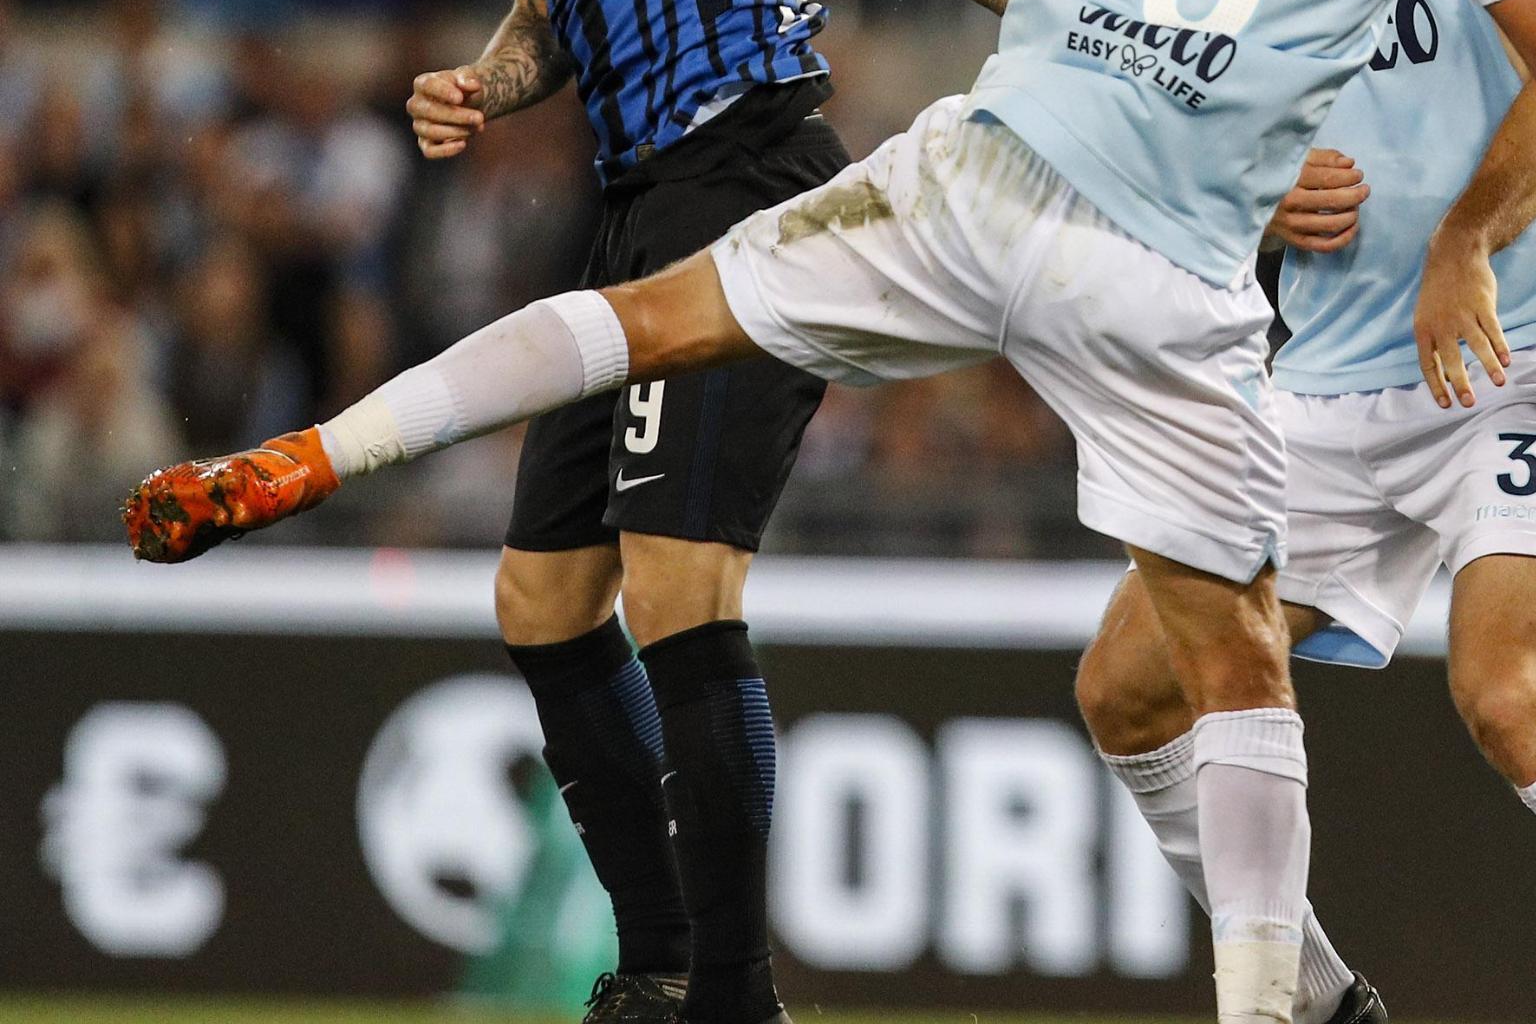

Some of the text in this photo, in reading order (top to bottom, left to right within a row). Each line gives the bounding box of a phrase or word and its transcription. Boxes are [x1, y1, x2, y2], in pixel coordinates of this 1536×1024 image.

[1067, 31, 1207, 110] EASY LIFE
[624, 379, 666, 455] 9
